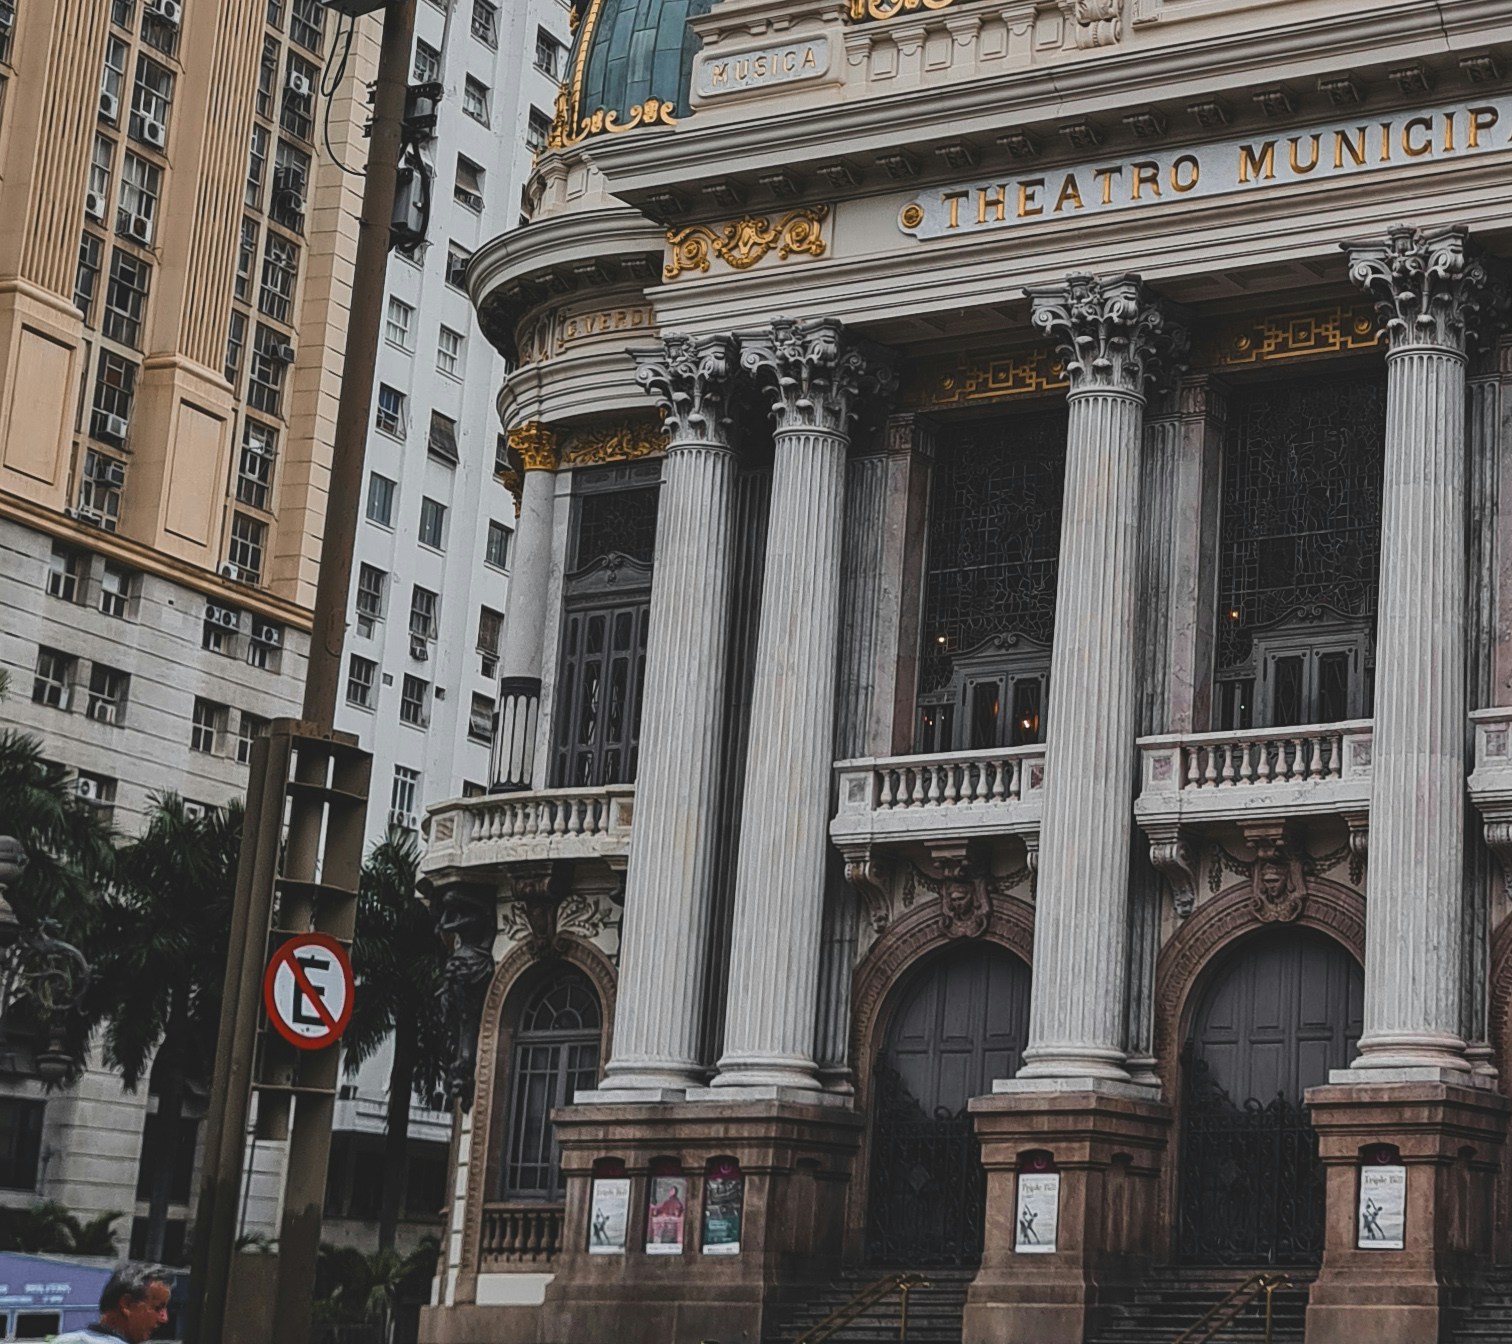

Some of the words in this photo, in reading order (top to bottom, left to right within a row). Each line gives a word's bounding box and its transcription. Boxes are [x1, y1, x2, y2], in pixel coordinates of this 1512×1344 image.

[712, 47, 817, 87] MUSICA
[941, 153, 1201, 229] THEATRO
[292, 955, 331, 1027] E
